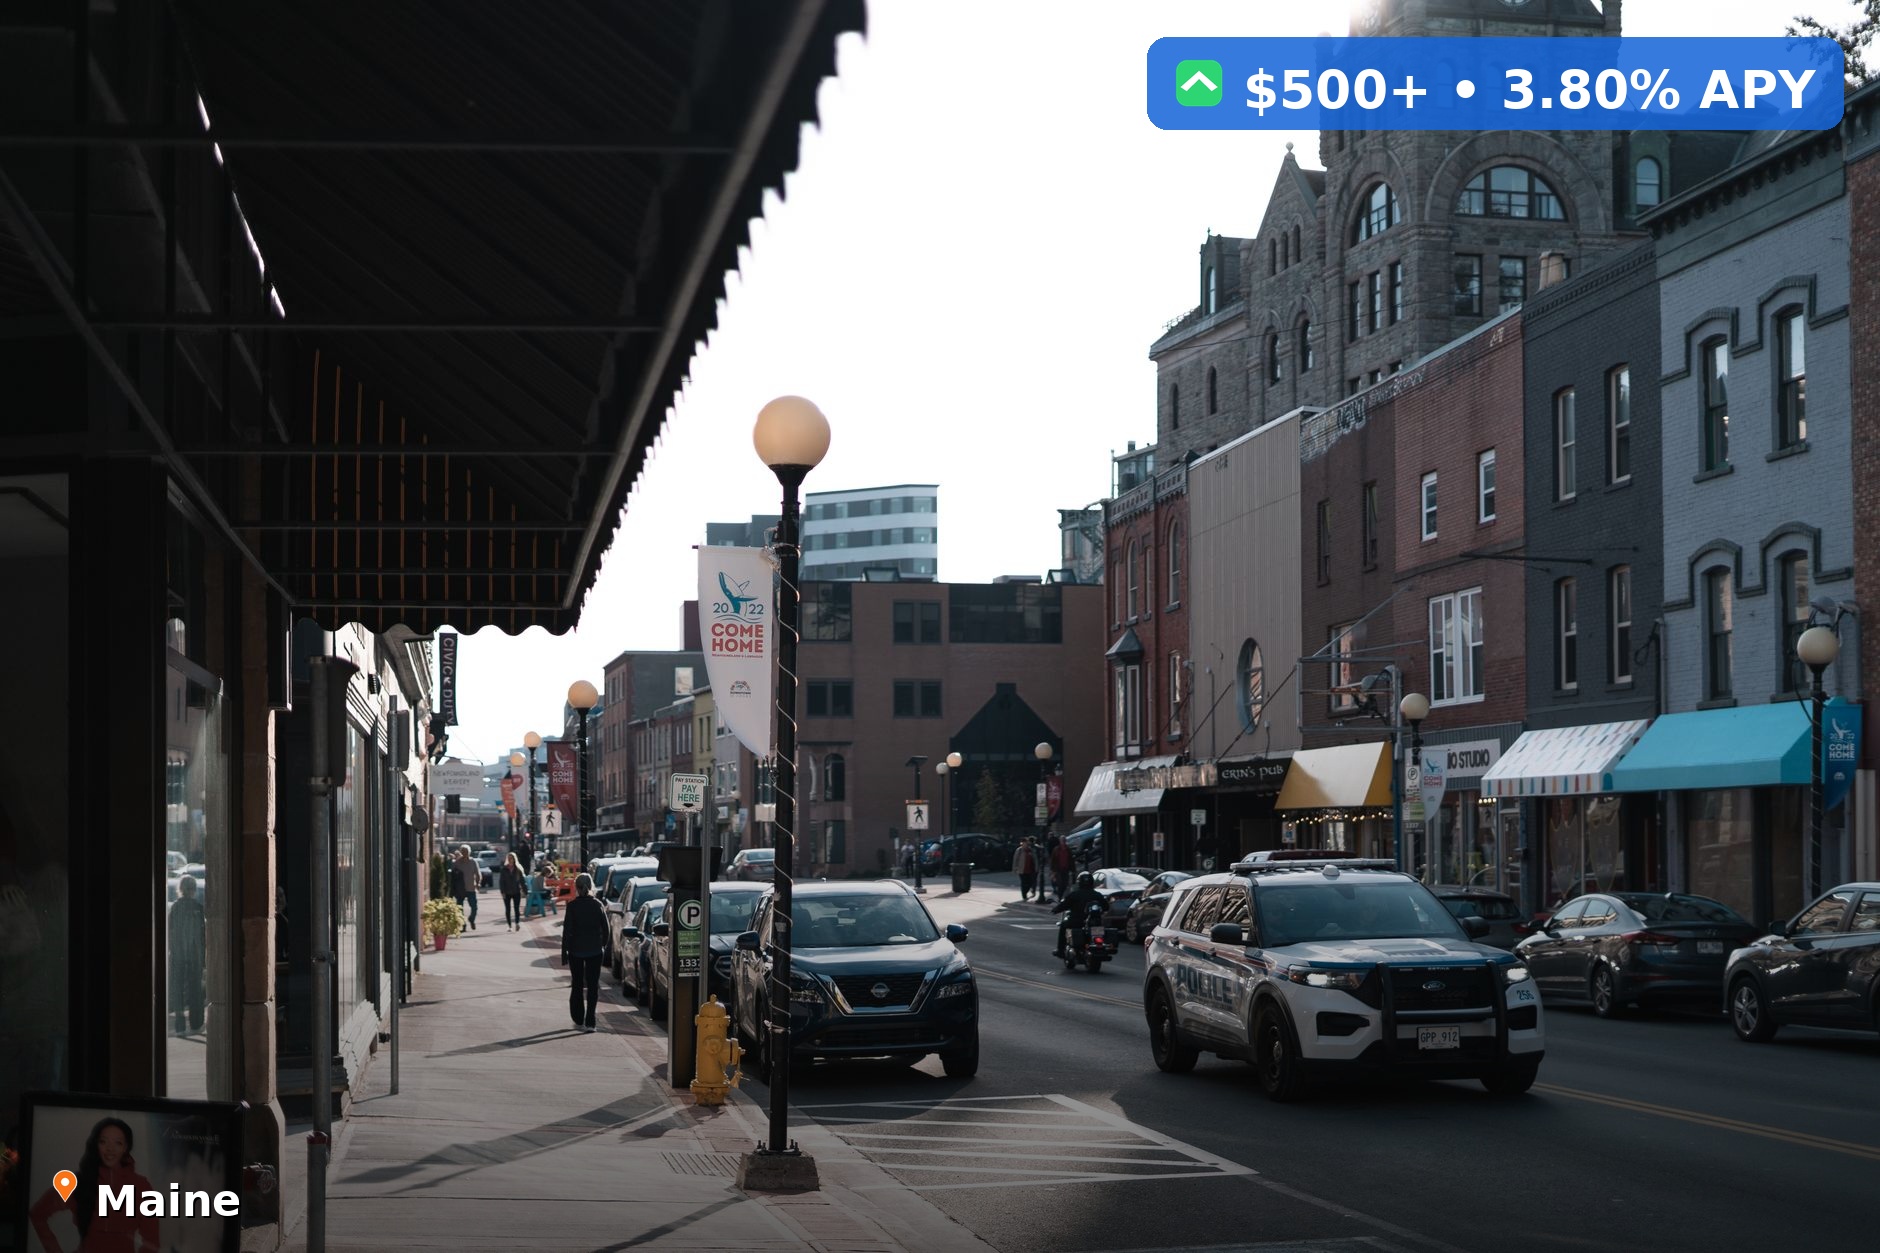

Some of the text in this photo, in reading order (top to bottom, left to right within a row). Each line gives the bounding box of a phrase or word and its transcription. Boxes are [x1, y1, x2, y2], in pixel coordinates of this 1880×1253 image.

[713, 603, 764, 615] 20 22
[711, 623, 764, 638] COME
[712, 638, 764, 653] HOME
[442, 637, 455, 676] CIVIC
[1829, 743, 1855, 751] COME
[1459, 749, 1490, 768] STUDIO
[1829, 751, 1855, 759] HOME
[682, 784, 697, 793] PAY
[678, 793, 700, 803] HERE
[687, 906, 700, 924] P
[1420, 1032, 1458, 1043] GPP 912
